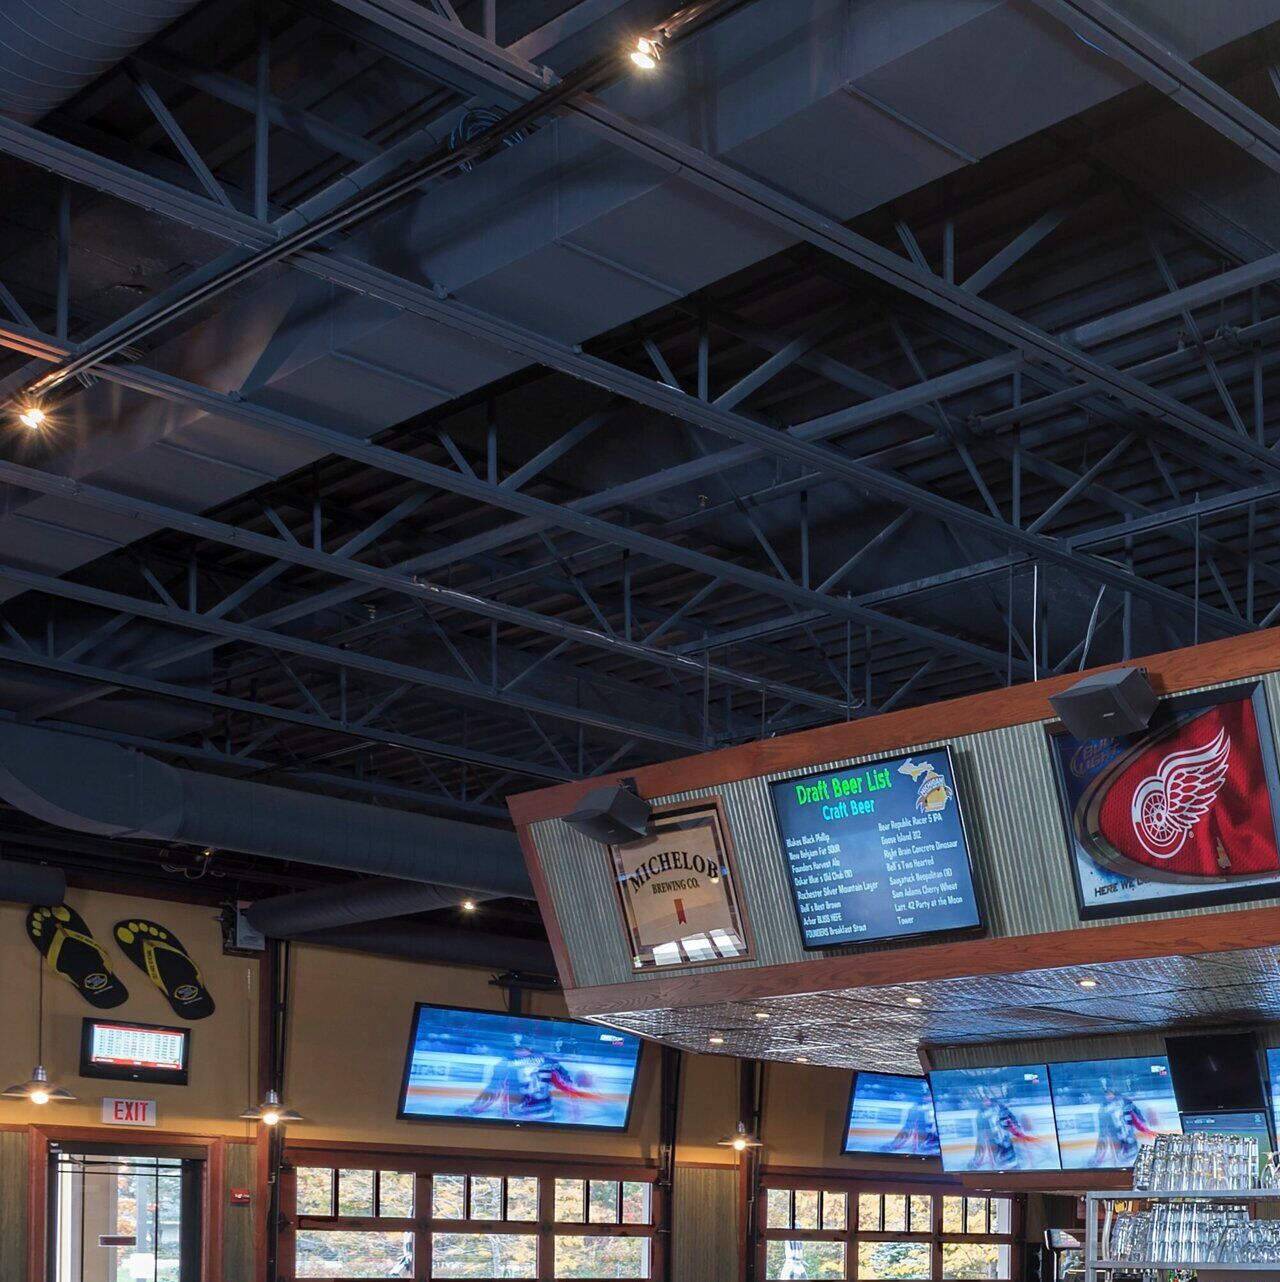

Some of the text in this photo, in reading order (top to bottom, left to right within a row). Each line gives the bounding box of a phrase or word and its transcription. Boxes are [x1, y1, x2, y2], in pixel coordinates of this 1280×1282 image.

[796, 768, 892, 805] Draft Beer List
[822, 799, 874, 821] Craft Beer
[628, 851, 718, 893] MICHELOB
[651, 878, 700, 894] BREWING CO.
[1095, 881, 1118, 897] HERE
[113, 1100, 149, 1122] EXIT
